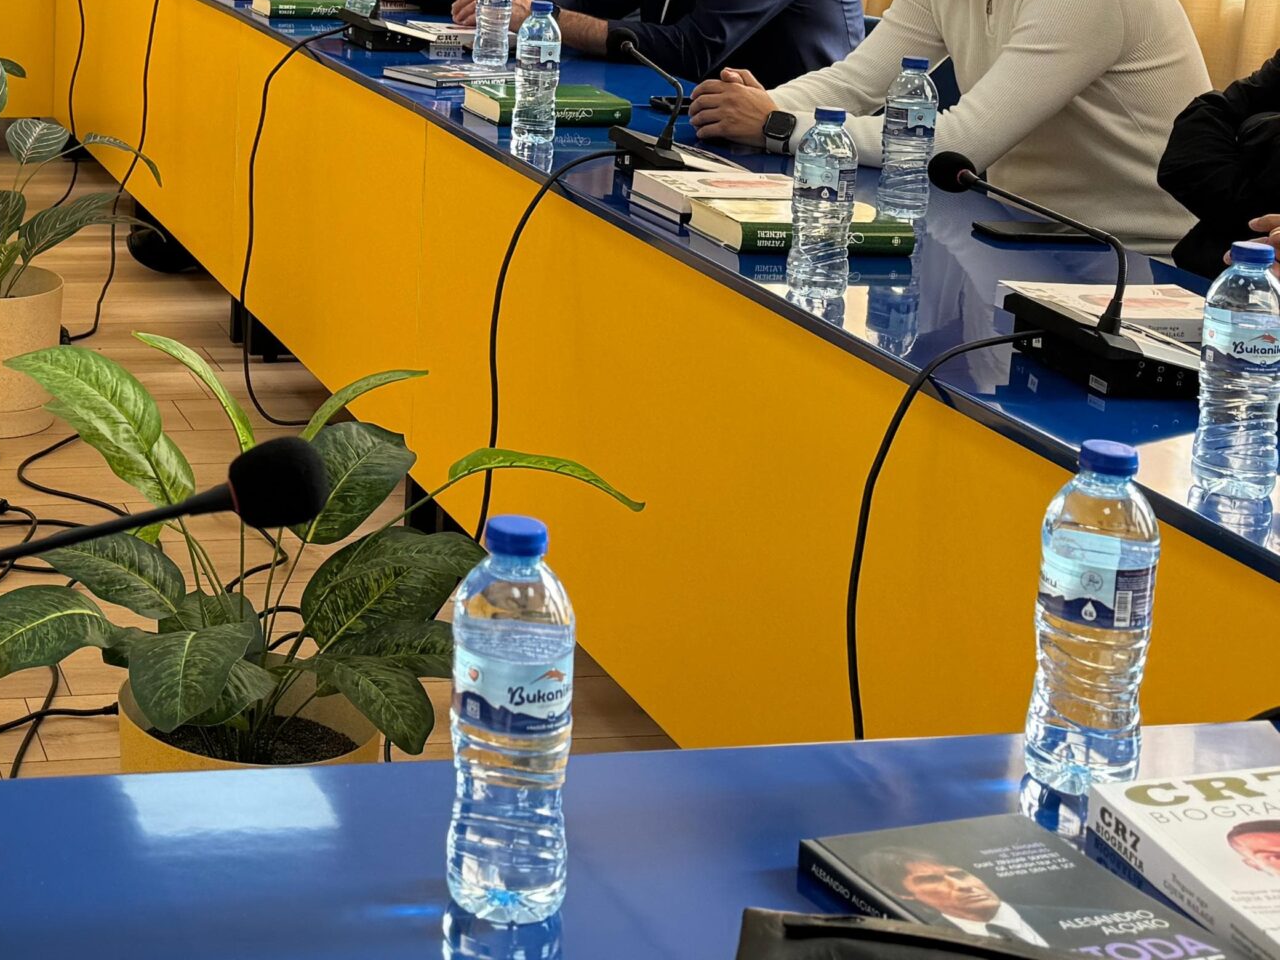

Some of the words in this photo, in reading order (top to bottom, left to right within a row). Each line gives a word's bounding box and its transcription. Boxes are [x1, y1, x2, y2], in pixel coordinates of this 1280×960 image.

[1095, 822, 1145, 874] BIOGRAFIA
[1099, 806, 1141, 853] CR7
[1058, 909, 1155, 931] ALESANDRO
